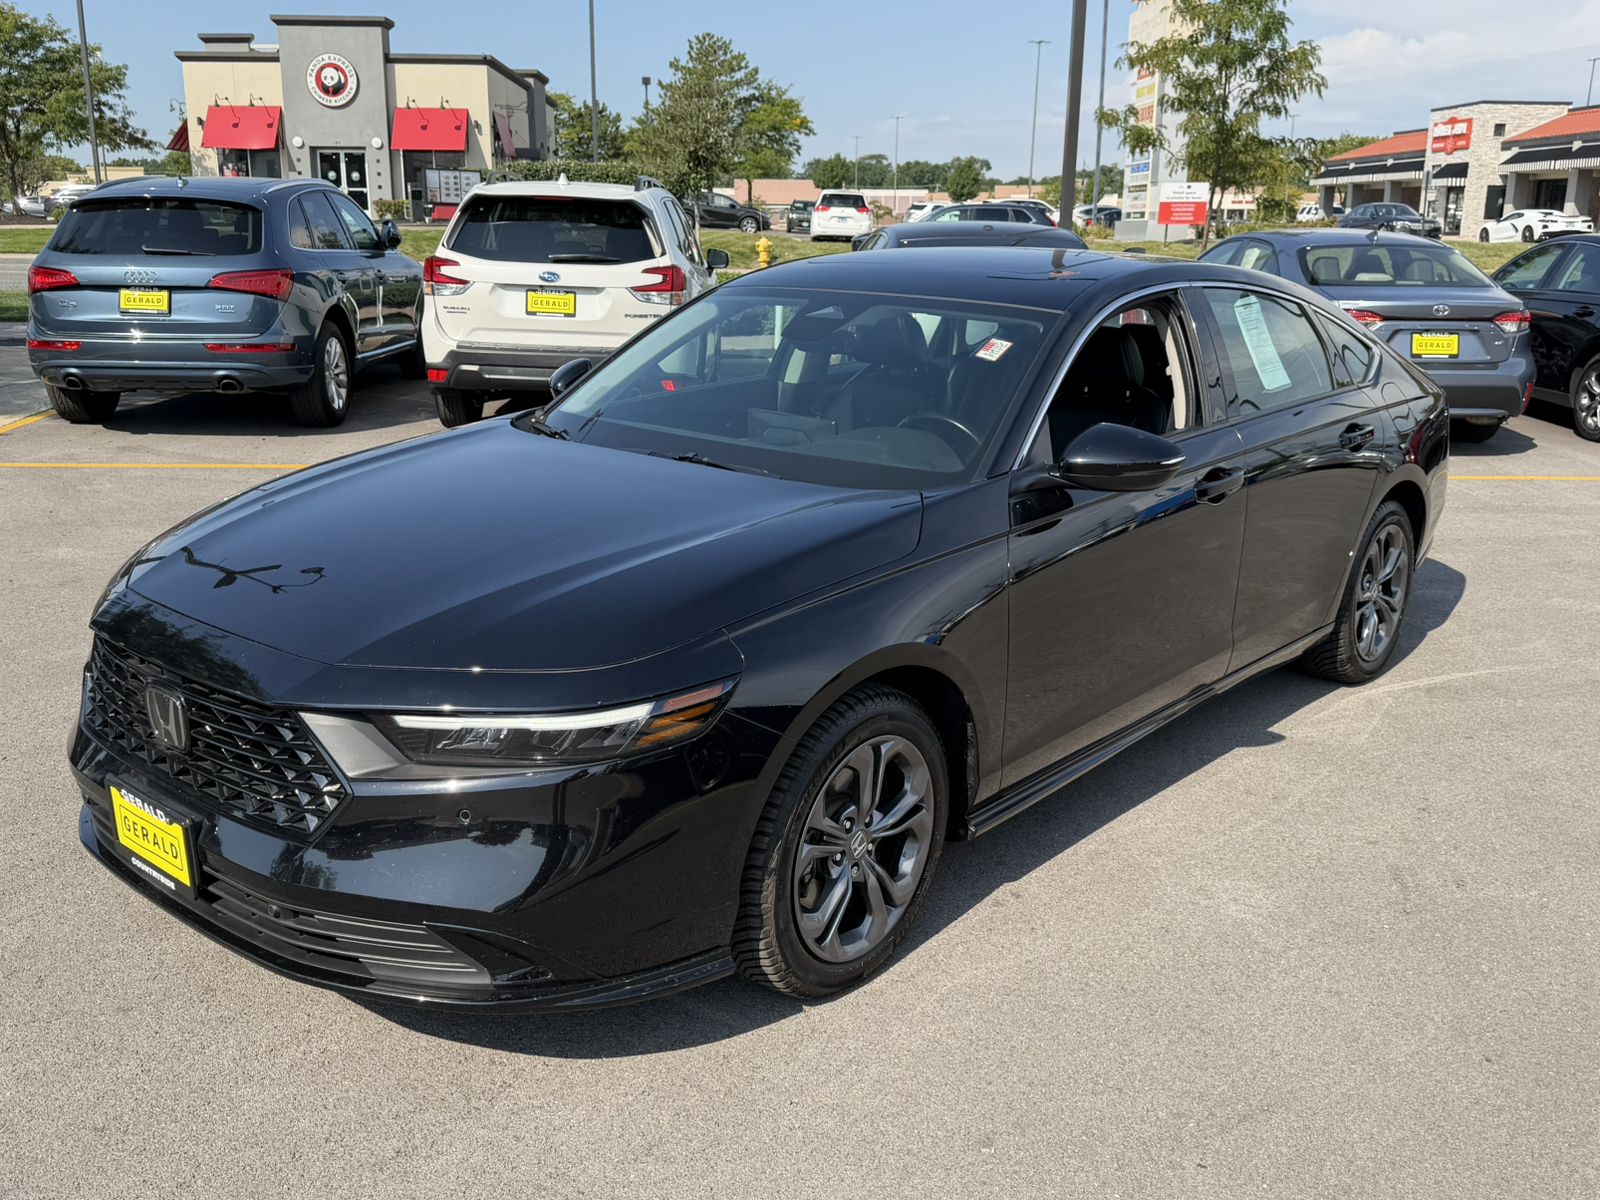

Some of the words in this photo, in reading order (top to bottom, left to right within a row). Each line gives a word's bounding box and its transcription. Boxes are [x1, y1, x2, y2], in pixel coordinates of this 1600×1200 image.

[309, 57, 326, 77] PANDA
[328, 55, 354, 78] EXPRESS
[311, 86, 332, 103] CHINESE
[334, 87, 354, 103] KITCHEN
[126, 296, 162, 304] GERALD
[533, 299, 568, 308] GERALD
[1418, 341, 1452, 349] GERALD
[120, 788, 166, 823] GERALD
[123, 815, 179, 860] GERALD
